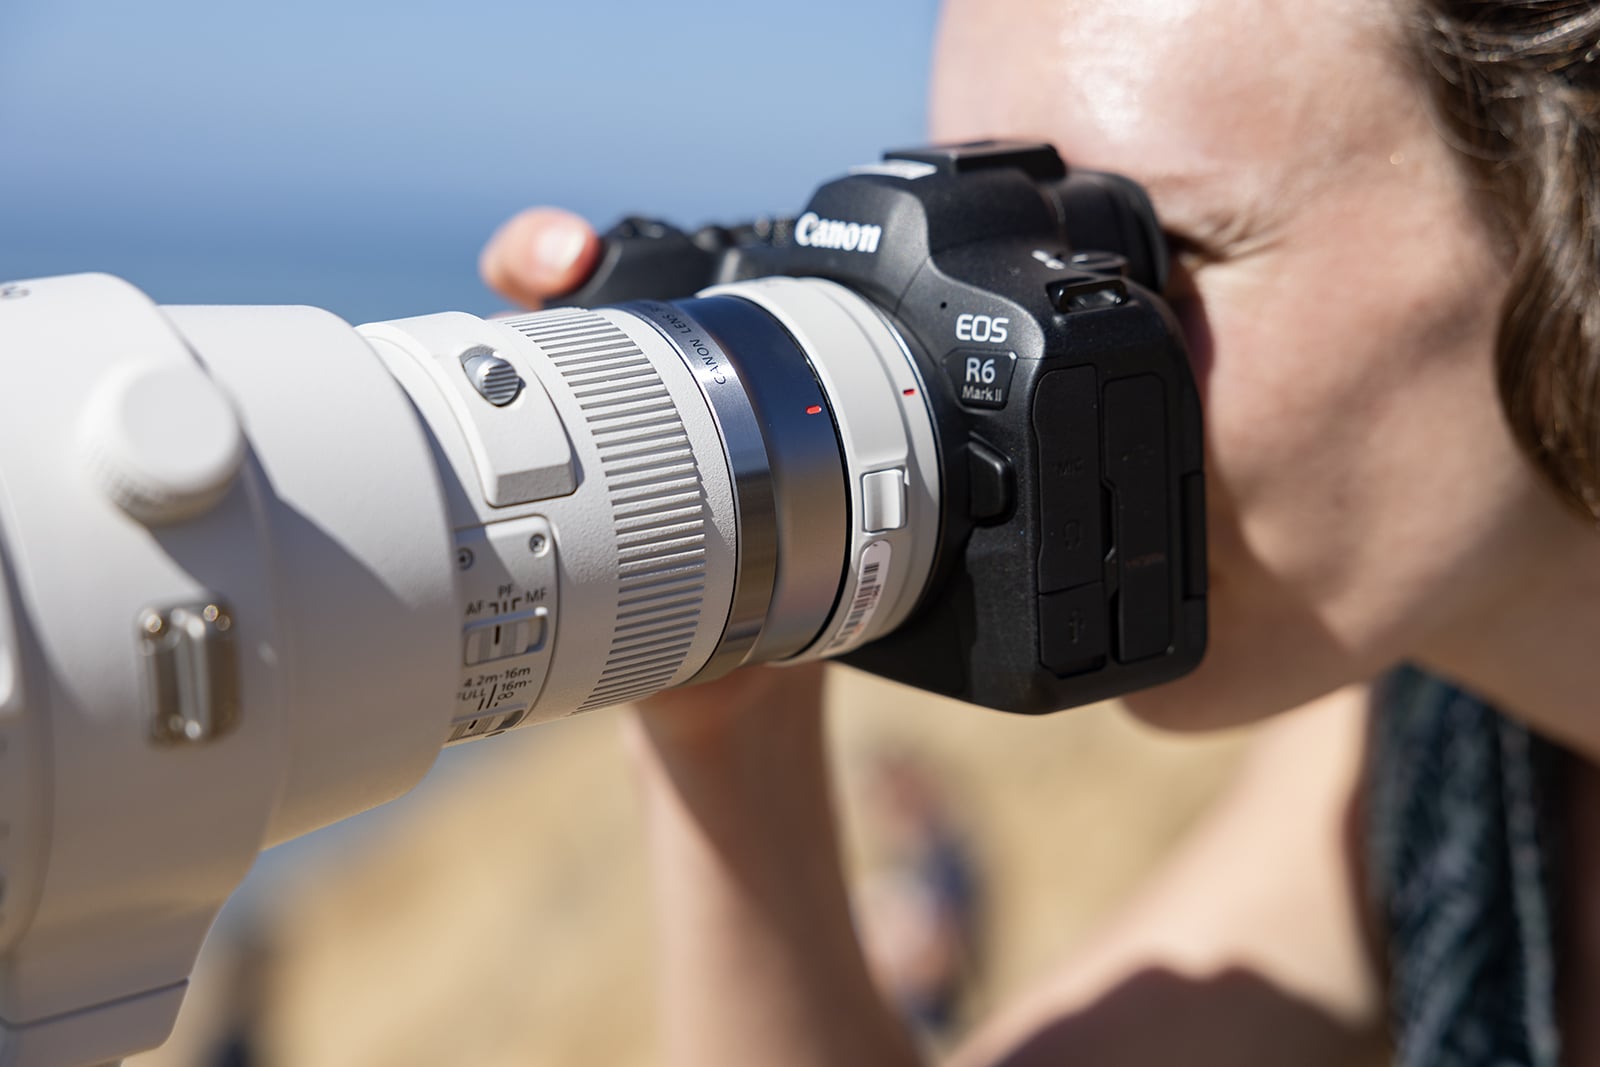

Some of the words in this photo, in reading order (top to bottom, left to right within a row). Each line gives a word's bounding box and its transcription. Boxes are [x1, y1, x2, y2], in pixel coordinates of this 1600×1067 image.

[795, 212, 882, 254] Canon
[662, 313, 692, 334] LENS
[956, 314, 1009, 343] EOS
[690, 338, 727, 385] CANON
[966, 357, 996, 384] R6
[962, 385, 993, 401] Mark
[498, 584, 513, 598] PF
[526, 587, 547, 603] MF
[466, 600, 484, 615] AF
